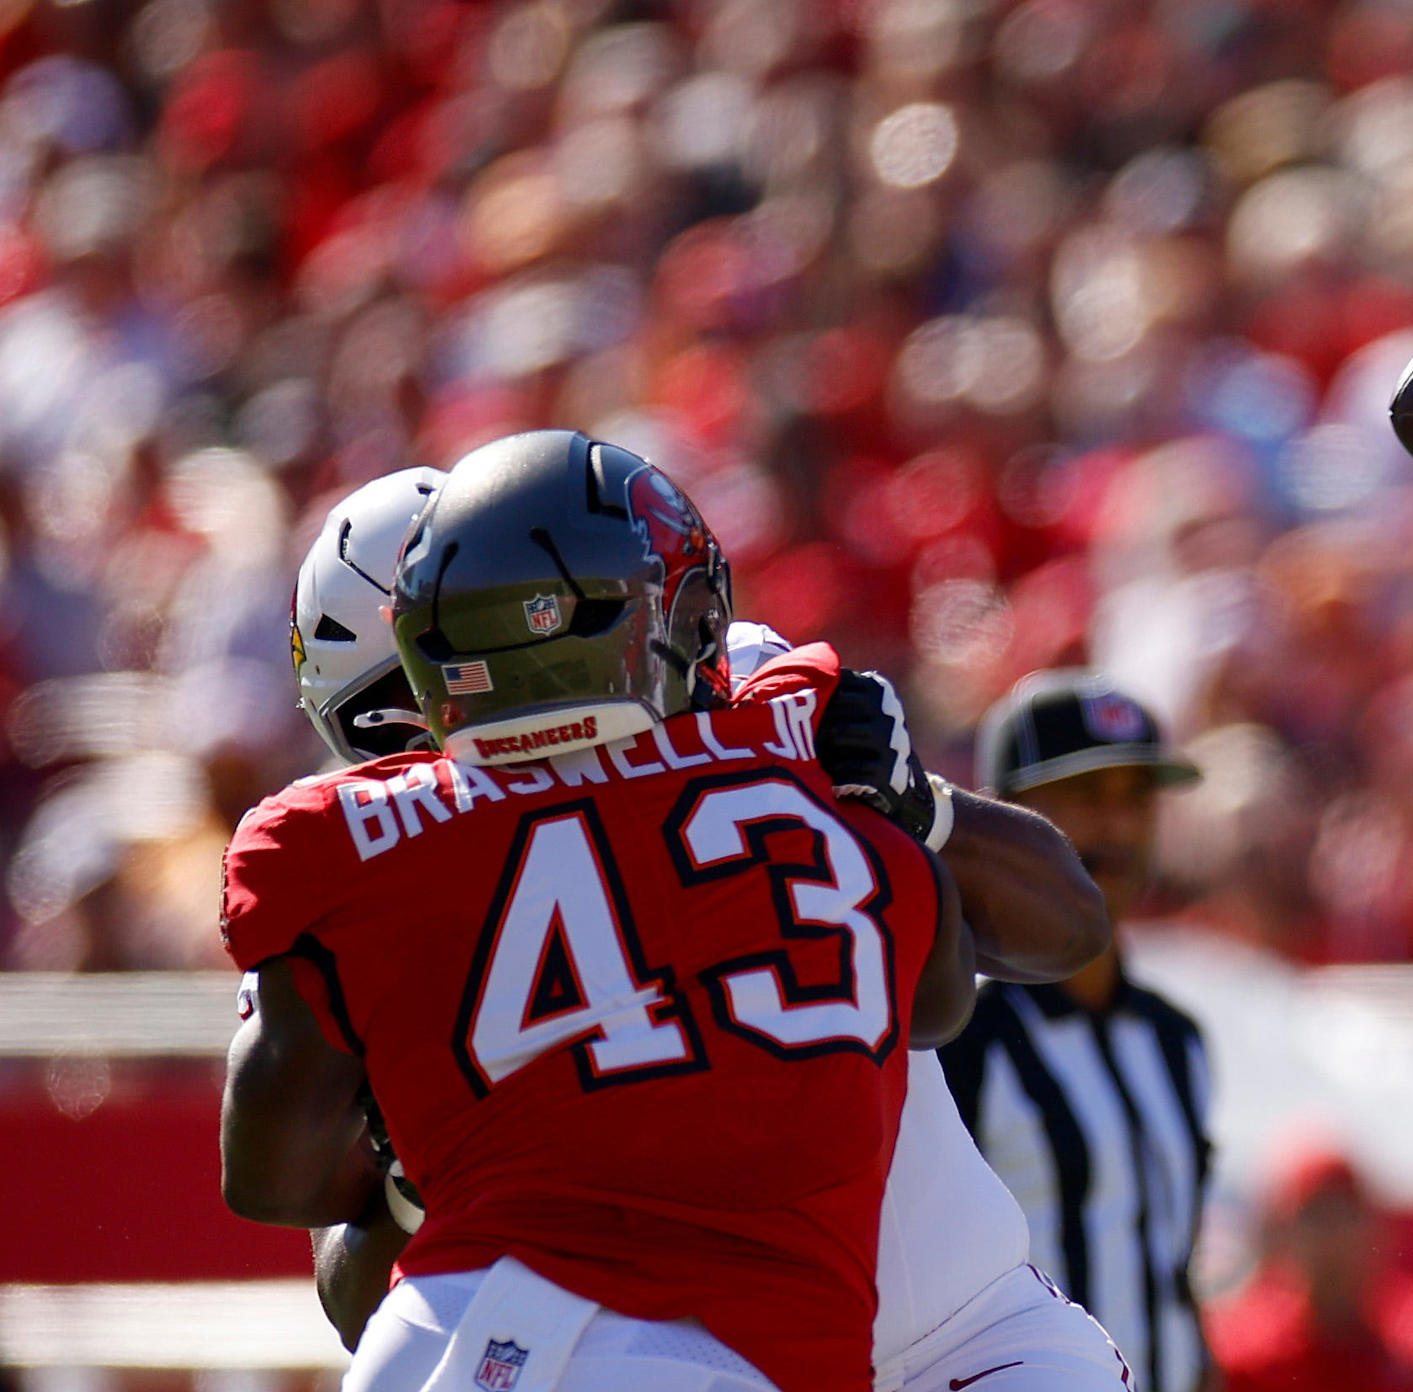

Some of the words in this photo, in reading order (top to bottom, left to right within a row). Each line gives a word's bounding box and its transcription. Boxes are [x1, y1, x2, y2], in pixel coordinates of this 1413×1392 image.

[530, 609, 557, 629] NFL
[472, 715, 598, 759] BUCCANEERS
[762, 687, 818, 762] JR
[452, 766, 900, 1099] 43
[478, 1358, 515, 1390] NFL
